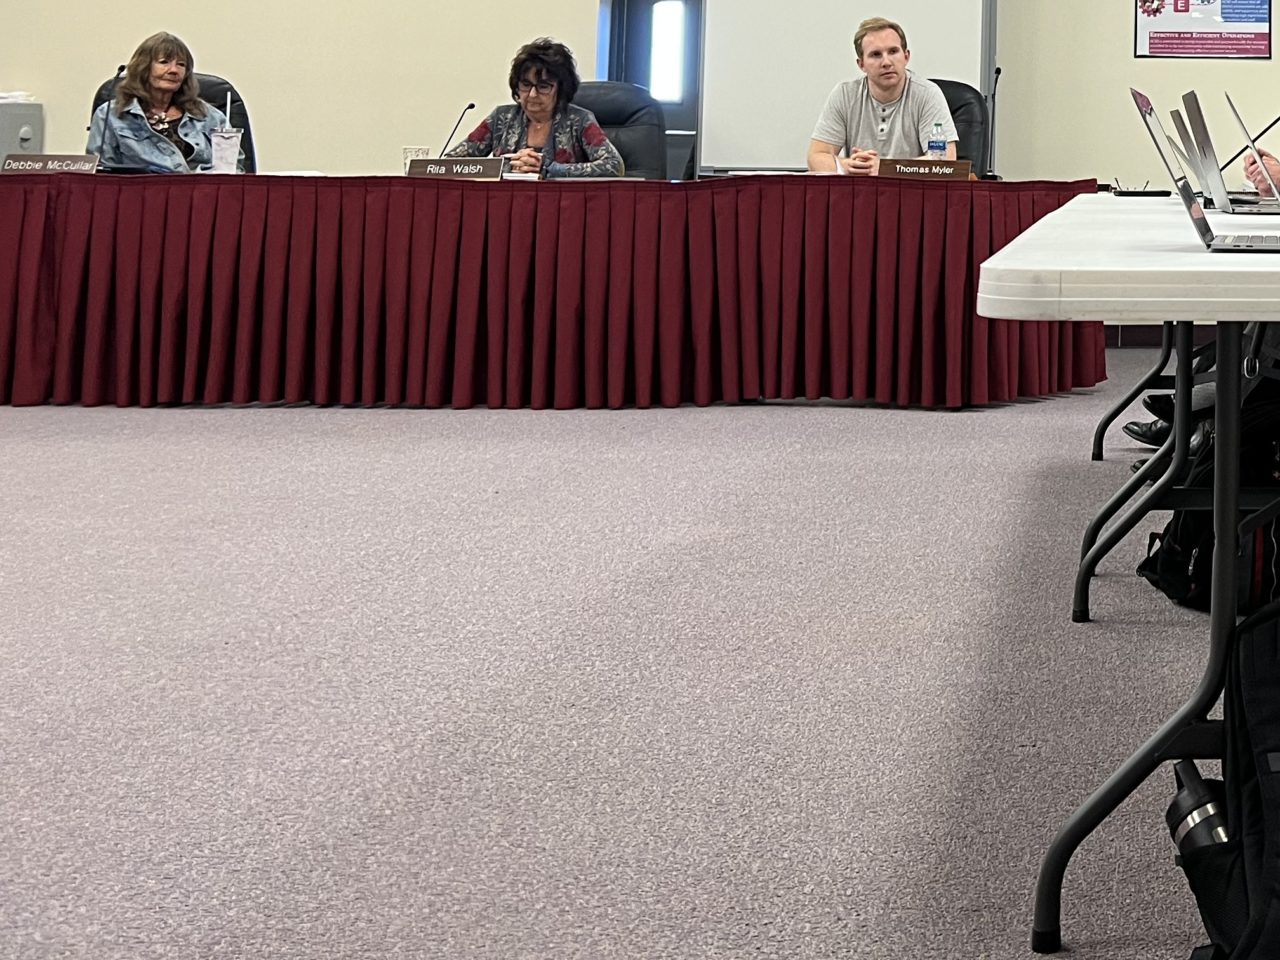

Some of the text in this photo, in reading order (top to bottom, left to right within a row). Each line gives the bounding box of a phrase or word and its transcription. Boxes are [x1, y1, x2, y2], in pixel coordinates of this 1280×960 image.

[1178, 1, 1185, 10] E
[4, 160, 93, 170] Debbie McCullar
[426, 164, 483, 174] Rita Walsh
[896, 165, 954, 174] Thomas Mylor
